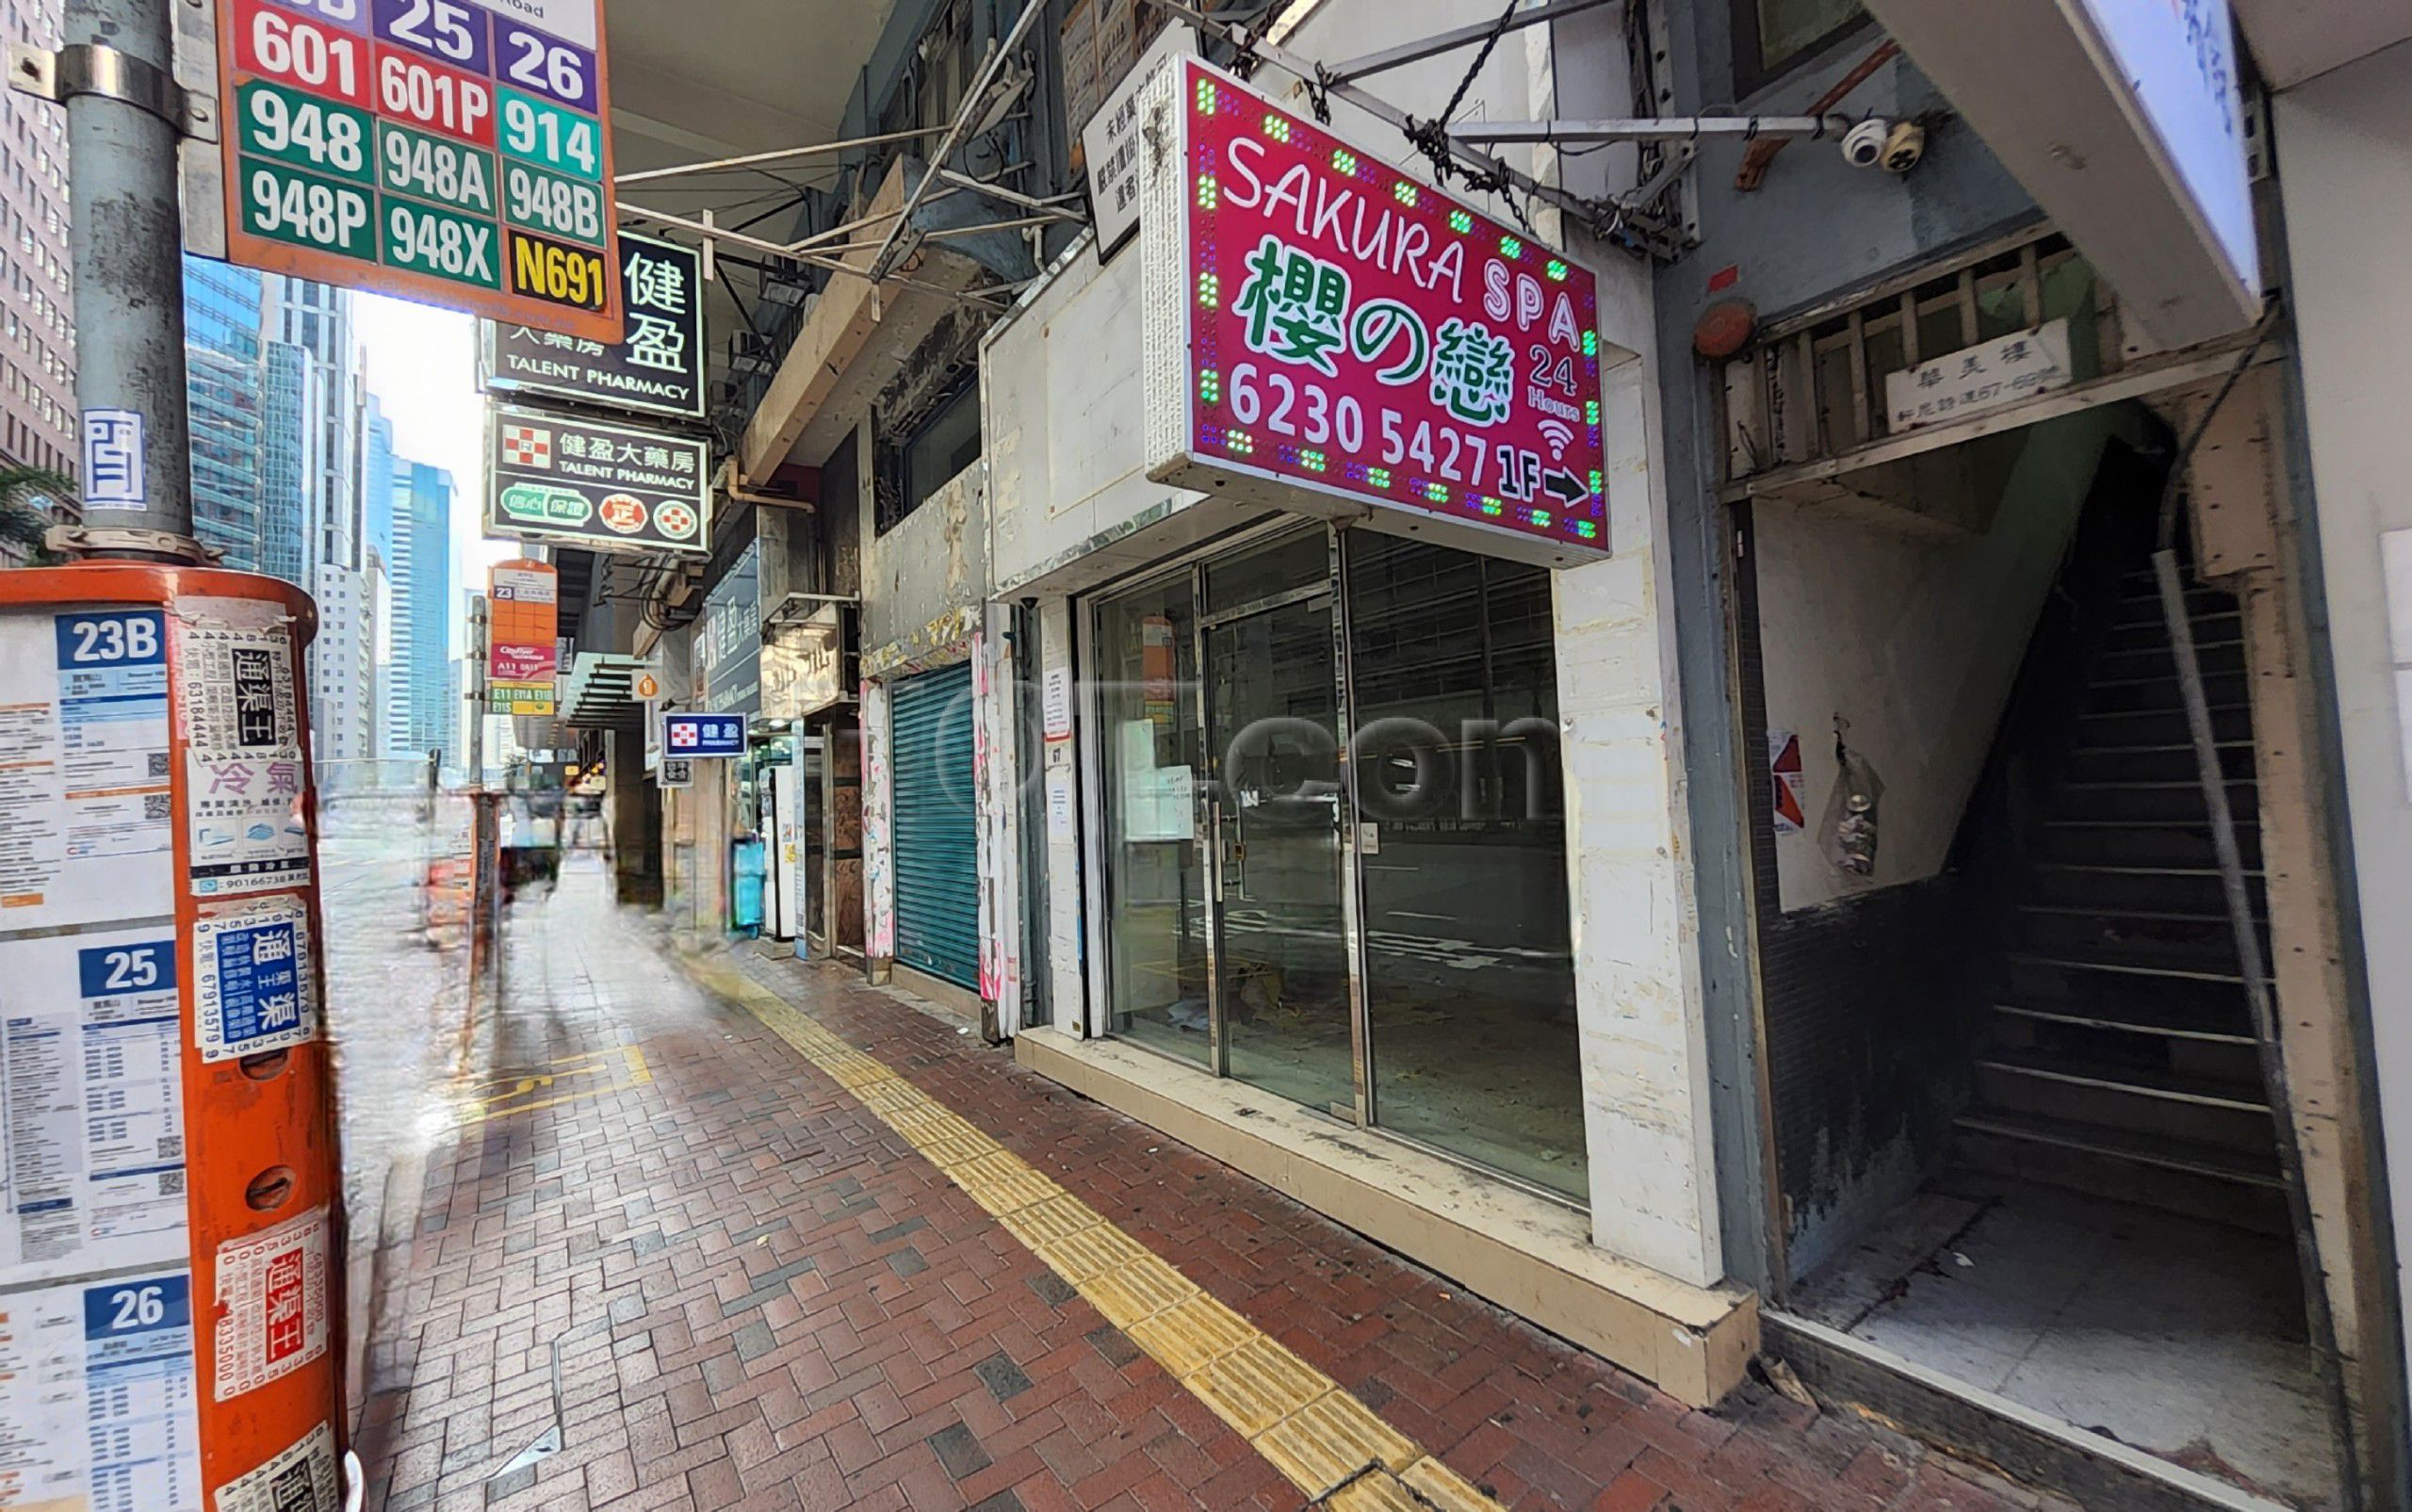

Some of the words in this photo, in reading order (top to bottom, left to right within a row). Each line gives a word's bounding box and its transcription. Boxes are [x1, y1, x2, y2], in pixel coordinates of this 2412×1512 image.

[253, 9, 355, 97] 601
[389, 0, 474, 60] 25
[508, 31, 584, 100] 26
[251, 89, 362, 172] 948
[381, 56, 488, 135] 601P
[385, 131, 491, 210] 948A
[506, 99, 595, 172] 914
[252, 171, 367, 248] 948P
[510, 168, 599, 239] 948B
[1224, 137, 1464, 305] SAKURA
[391, 207, 493, 282] 948X
[515, 236, 603, 307] N691
[624, 252, 689, 374] 健盈
[1484, 258, 1580, 354] SPA
[507, 354, 580, 382] TALENT
[586, 368, 691, 401] PHARMACY
[1527, 385, 1581, 423] Hours
[1529, 345, 1577, 398] 24
[559, 431, 695, 475] 健盈大藥房
[1229, 363, 1364, 455] 6230
[1382, 409, 1487, 486] 5427
[559, 460, 611, 481] TALENT
[617, 469, 695, 492] PHARMACY
[1497, 444, 1541, 503] 1F
[73, 617, 158, 662] 23B
[187, 682, 209, 748] 63184444
[235, 650, 273, 742] 通渠王
[208, 761, 298, 794] 冷氣
[104, 949, 158, 989] 25
[201, 974, 221, 1043] 67913579
[110, 1285, 163, 1329] 26
[267, 1253, 302, 1359] 通渠王
